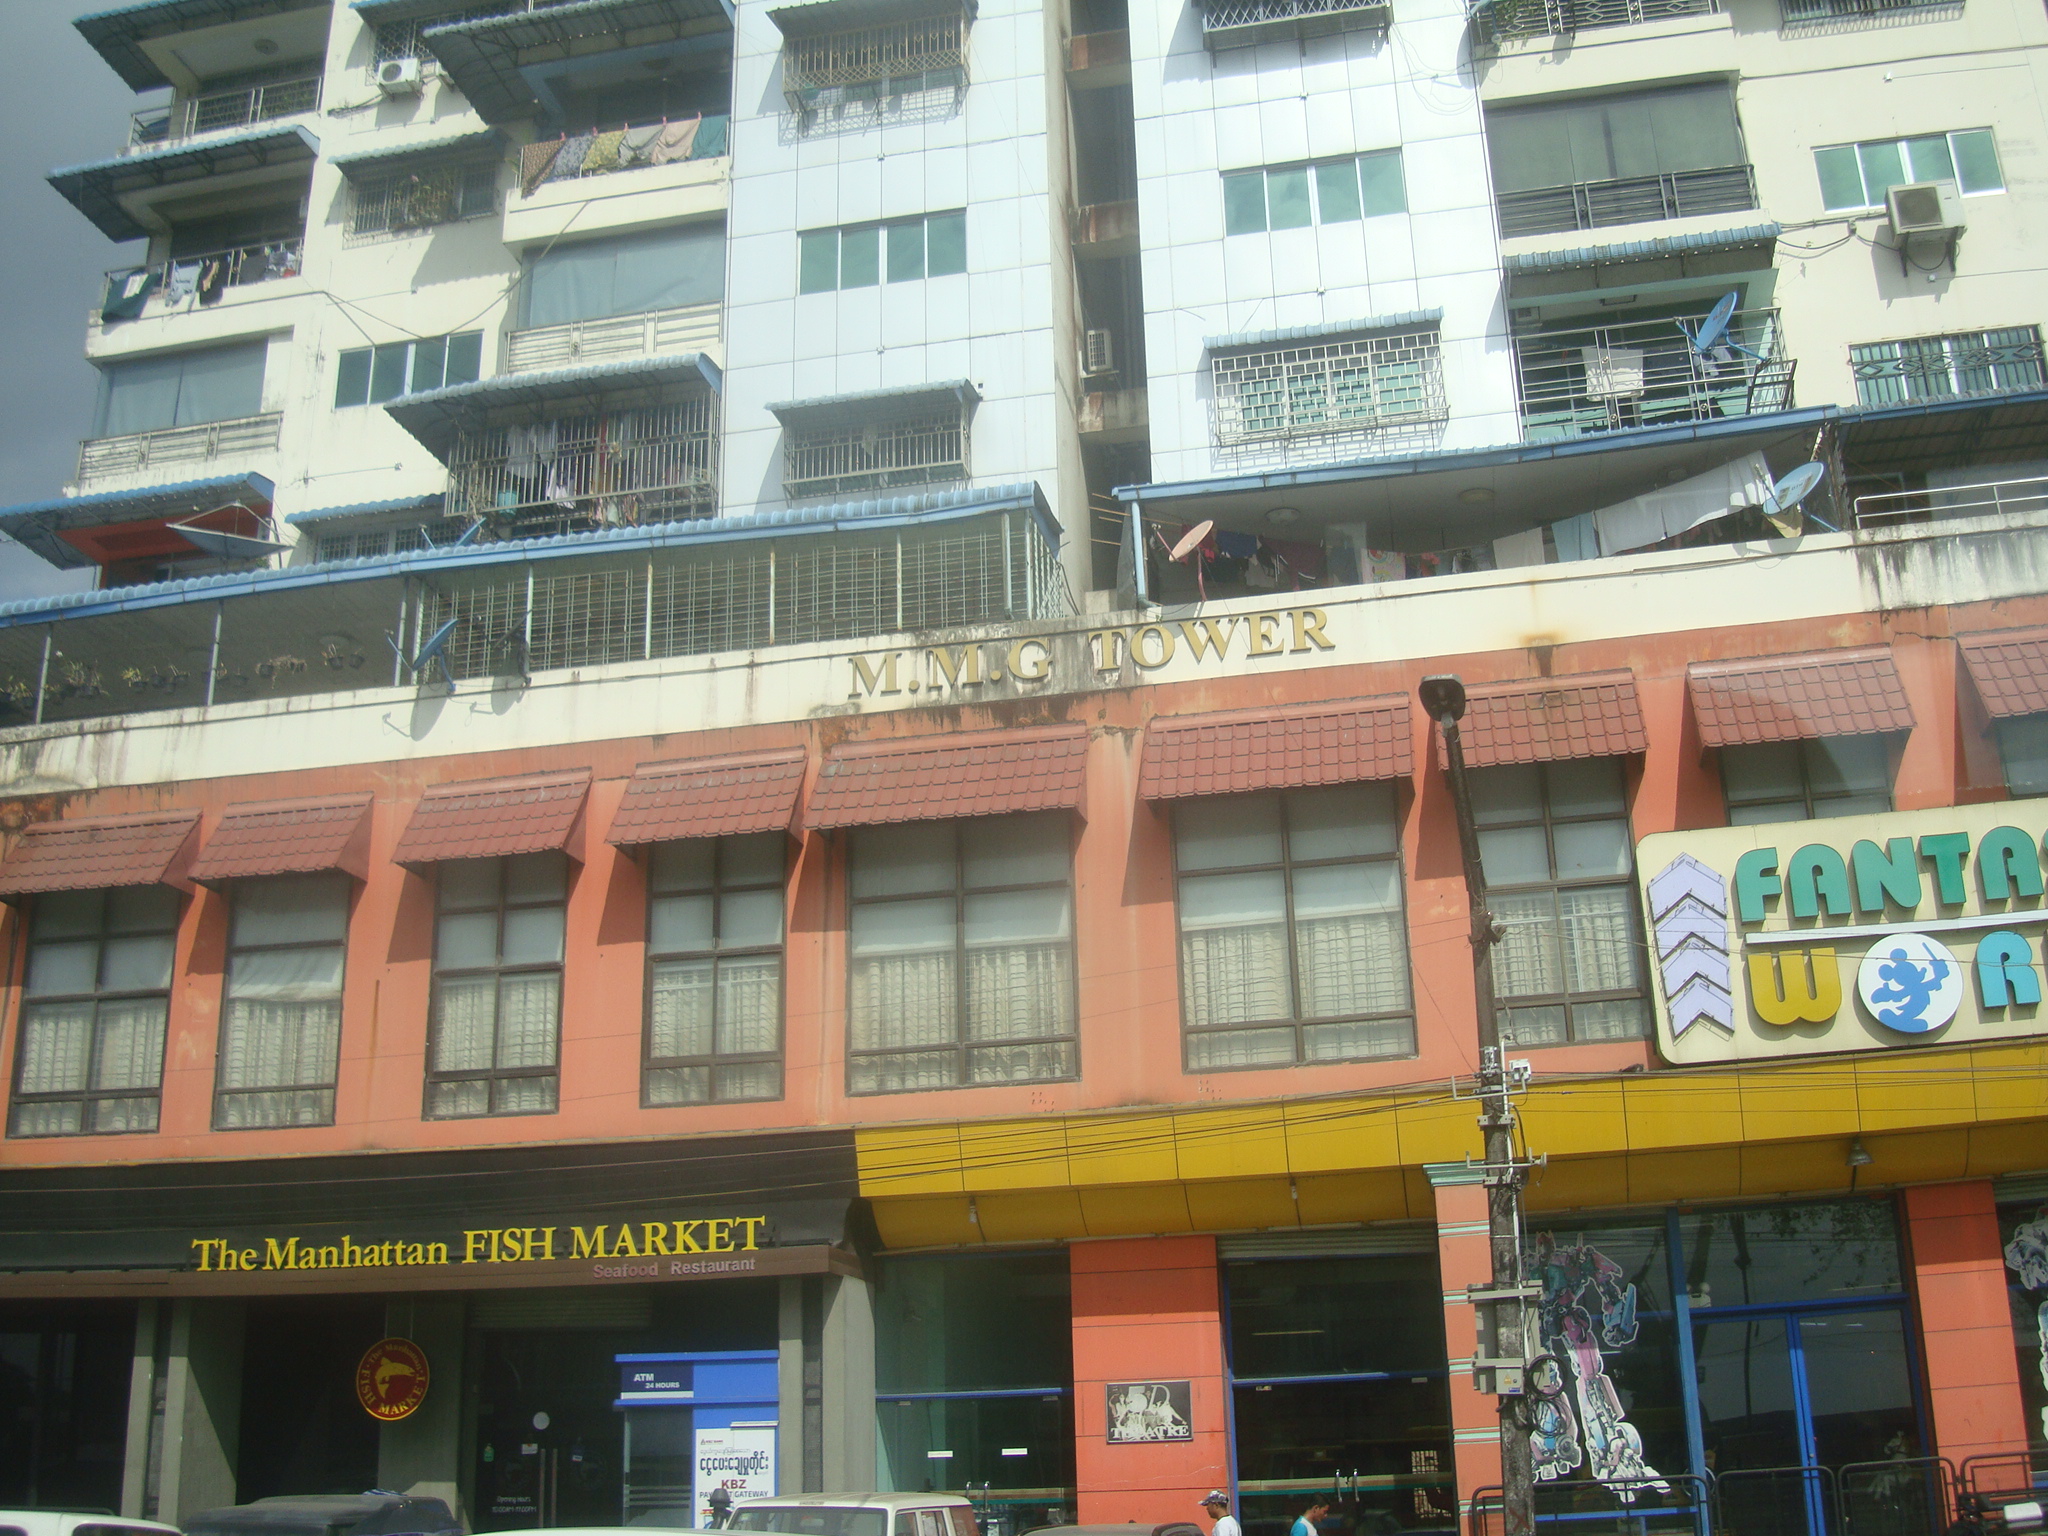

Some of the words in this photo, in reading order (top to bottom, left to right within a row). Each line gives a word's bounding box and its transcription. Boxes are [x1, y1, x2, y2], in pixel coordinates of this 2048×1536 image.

[848, 637, 1053, 700] M.M.G
[1088, 607, 1336, 675] TOWER
[1735, 825, 2048, 923] FANTA
[191, 1238, 257, 1271] The
[262, 1234, 449, 1270] Manhattan
[462, 1227, 557, 1264] FISH
[569, 1215, 766, 1259] MARKET
[593, 1262, 659, 1279] Seafood
[670, 1257, 756, 1276] Restaurant
[633, 1373, 654, 1382] ATM
[655, 1381, 680, 1389] HOURS
[1111, 1425, 1190, 1439] TATRE
[721, 1479, 747, 1490] KBZ
[699, 1490, 733, 1499] PAYT
[734, 1490, 769, 1498] GATEWAY
